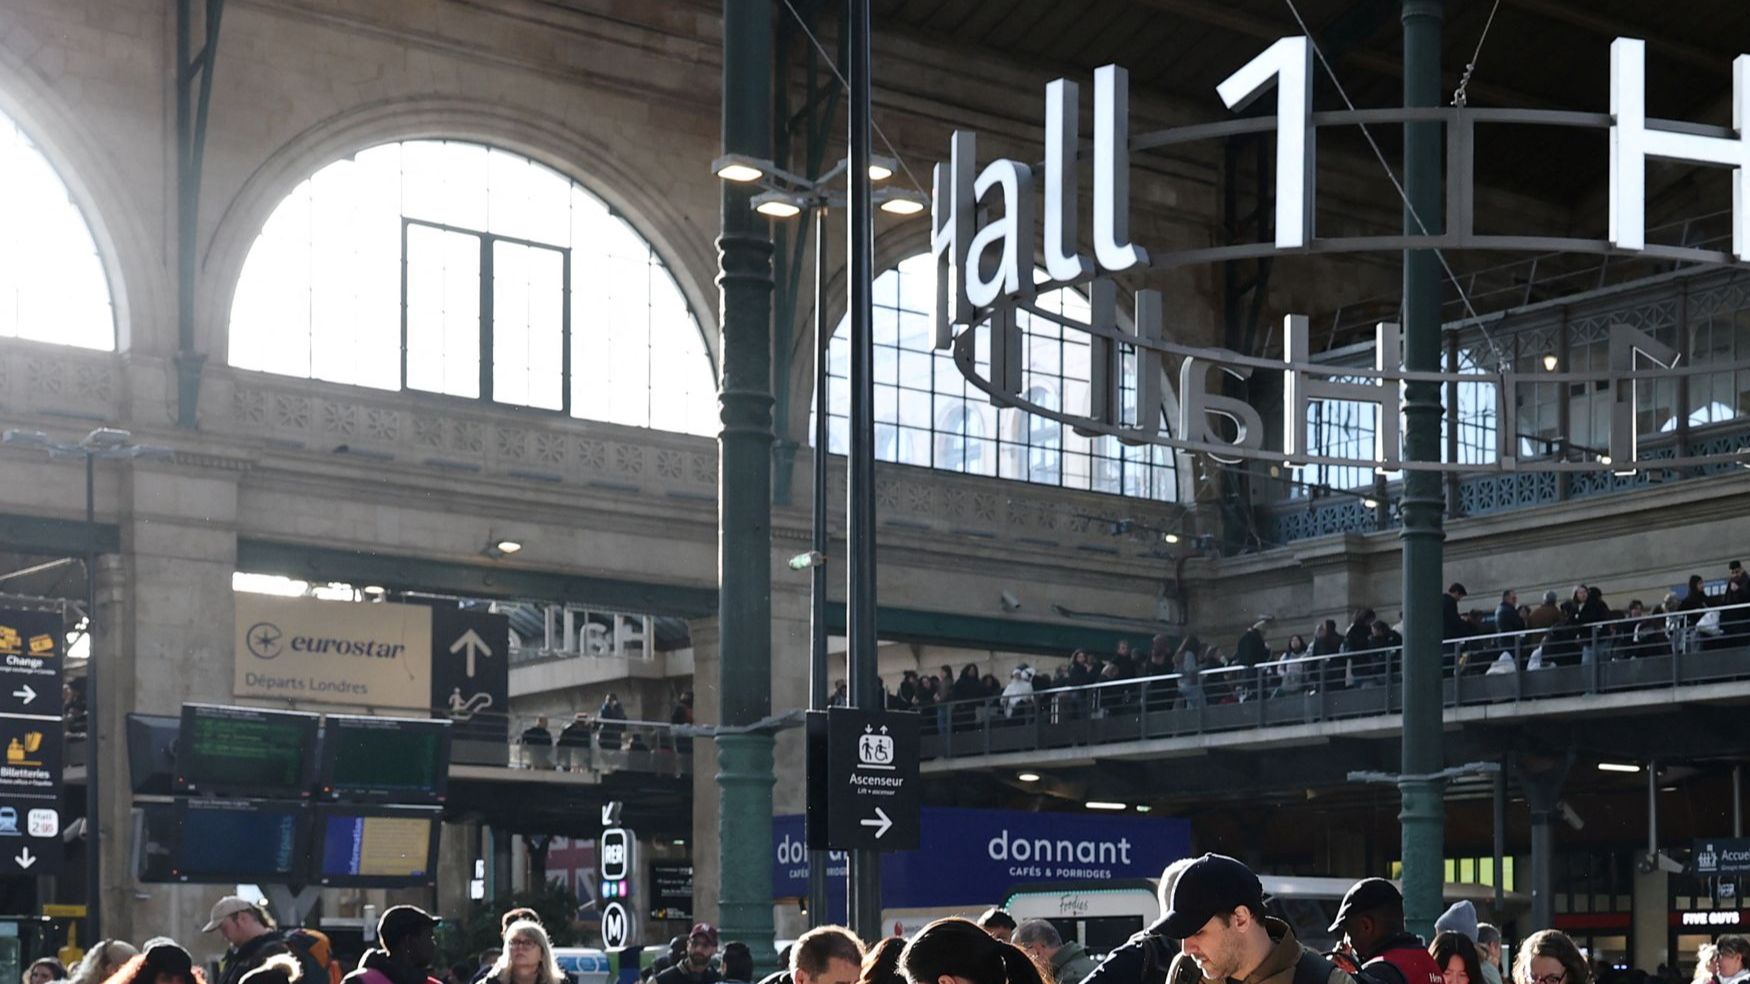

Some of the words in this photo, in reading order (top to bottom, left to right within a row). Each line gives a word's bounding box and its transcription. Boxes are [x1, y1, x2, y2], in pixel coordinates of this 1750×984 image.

[929, 64, 1148, 352] Hall
[1216, 36, 1314, 250] 1
[290, 634, 406, 660] eurostar
[6, 654, 44, 669] Change
[245, 671, 305, 690] Départs
[309, 677, 368, 695] Londres
[849, 773, 904, 787] Ascenseur
[605, 844, 623, 865] RER
[988, 829, 1132, 865] donnant
[1009, 866, 1042, 878] CAFÉS
[1045, 869, 1052, 878] &
[1056, 868, 1112, 879] PORRIDGES
[607, 914, 622, 942] M
[1682, 912, 1708, 925] FIVE
[1708, 911, 1740, 925] GUYS
